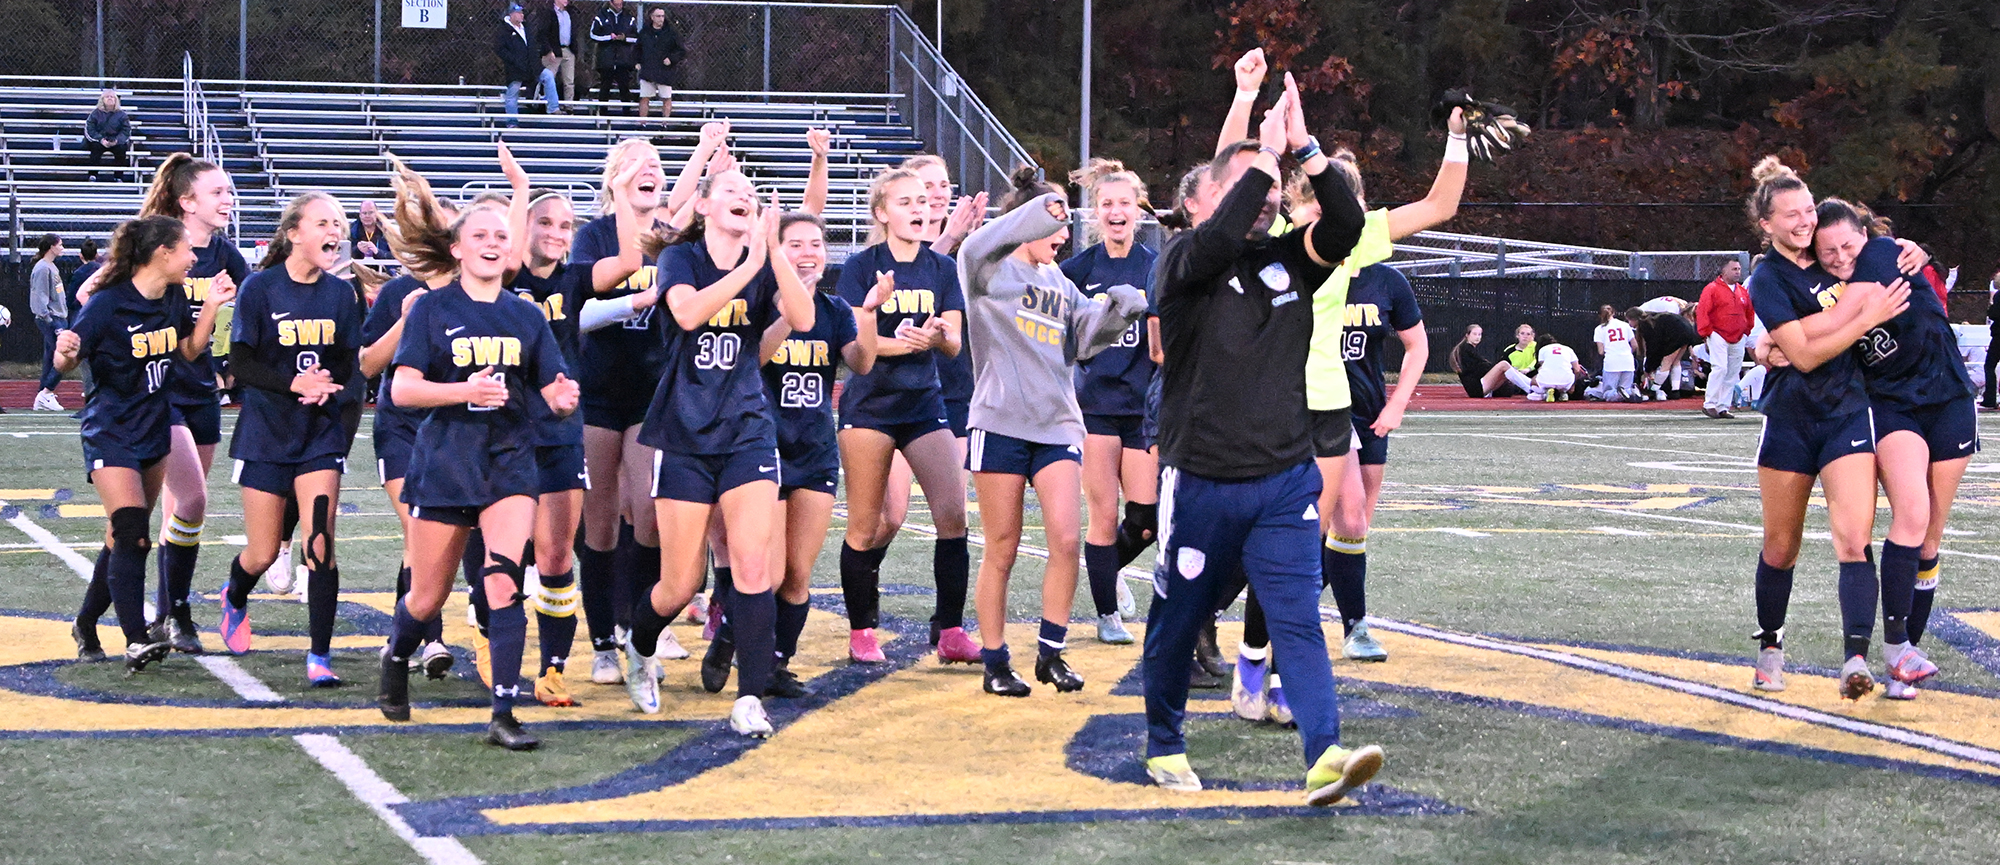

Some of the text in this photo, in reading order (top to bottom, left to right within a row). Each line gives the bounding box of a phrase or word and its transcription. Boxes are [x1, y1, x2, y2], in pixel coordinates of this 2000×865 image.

[419, 8, 429, 23] B
[183, 277, 213, 302] SW
[880, 289, 935, 314] SWR
[1817, 280, 1848, 312] SW
[709, 299, 752, 327] WR
[1343, 304, 1382, 326] WR
[131, 326, 178, 358] SWR
[278, 319, 336, 346] SWR
[1110, 319, 1140, 347] 8
[1608, 328, 1625, 342] 21
[451, 336, 521, 367] SWR
[694, 331, 742, 370] 30
[771, 339, 830, 367] SWR
[1552, 346, 1562, 355] 2
[1859, 327, 1898, 367] 22
[780, 371, 823, 408] 29
